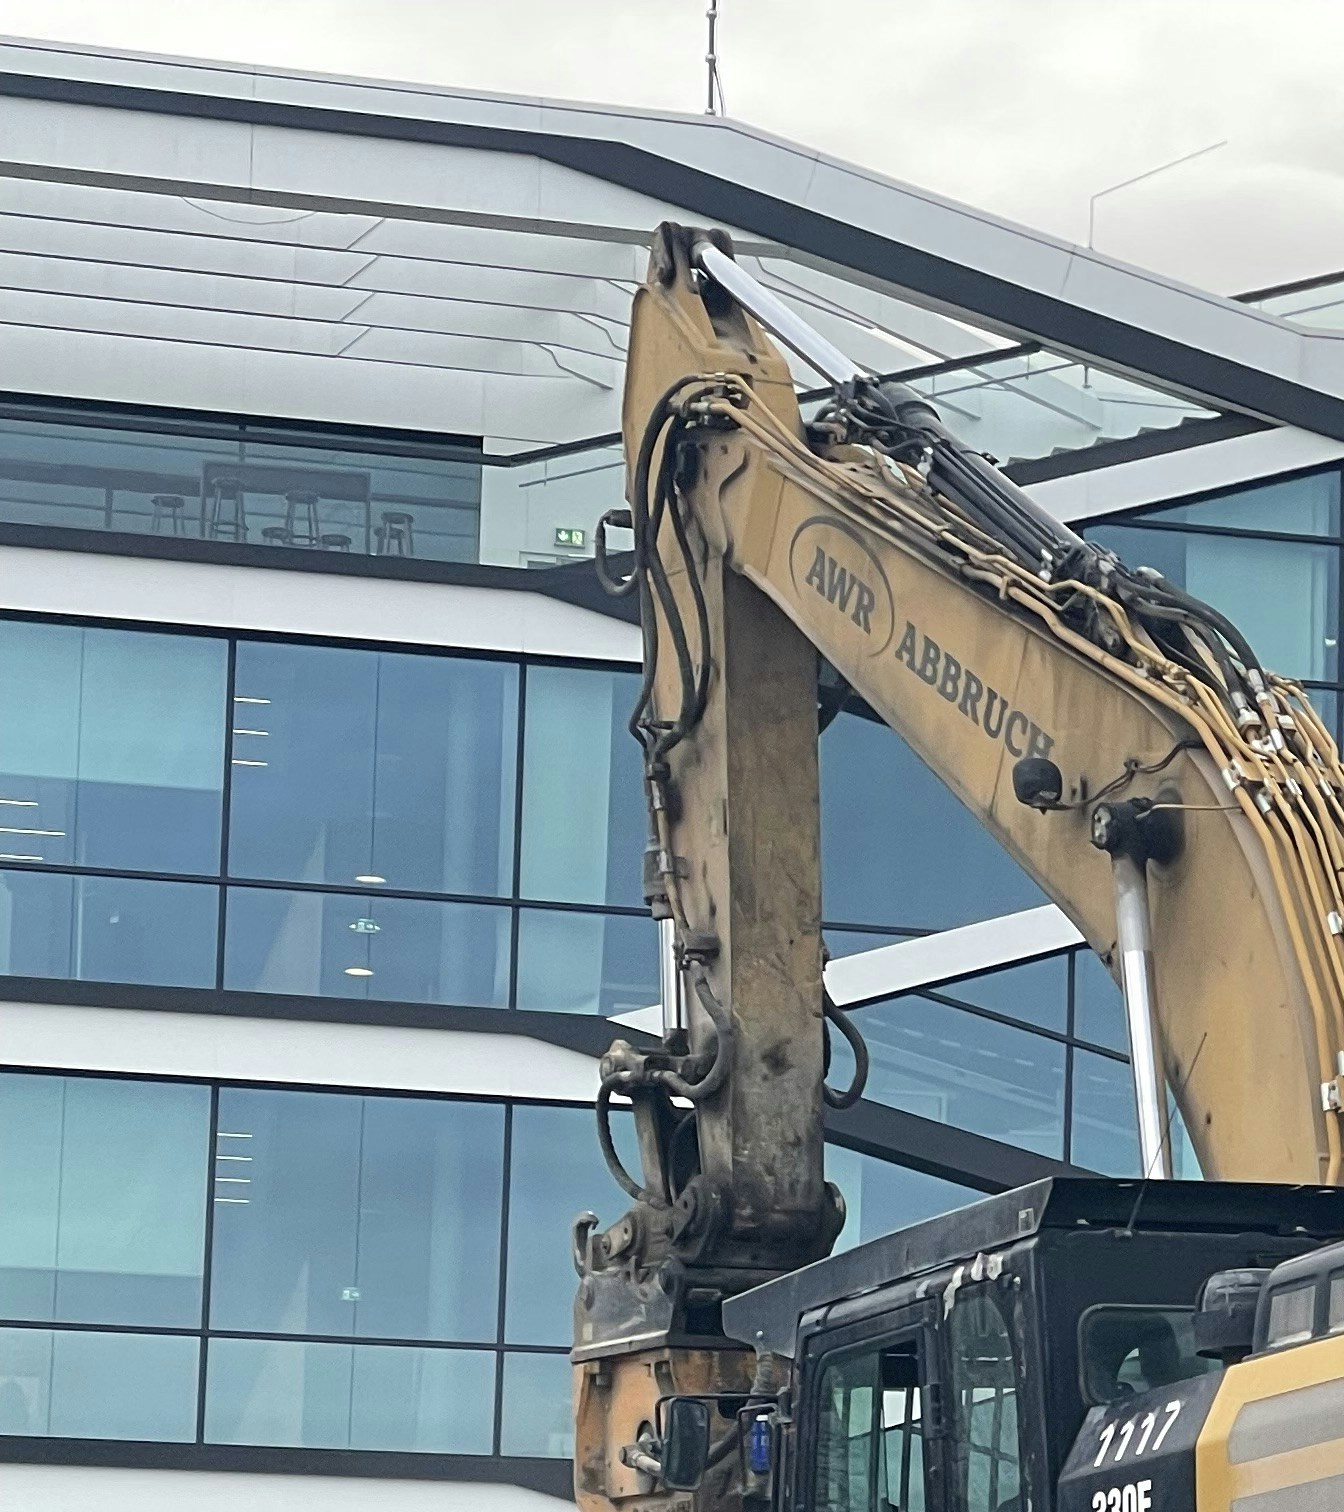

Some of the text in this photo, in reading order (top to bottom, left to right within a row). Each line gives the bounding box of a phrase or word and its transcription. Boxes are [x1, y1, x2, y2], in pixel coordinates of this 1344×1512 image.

[804, 545, 1055, 759] AWR ABBRUCH
[1093, 1399, 1181, 1468] 1117
